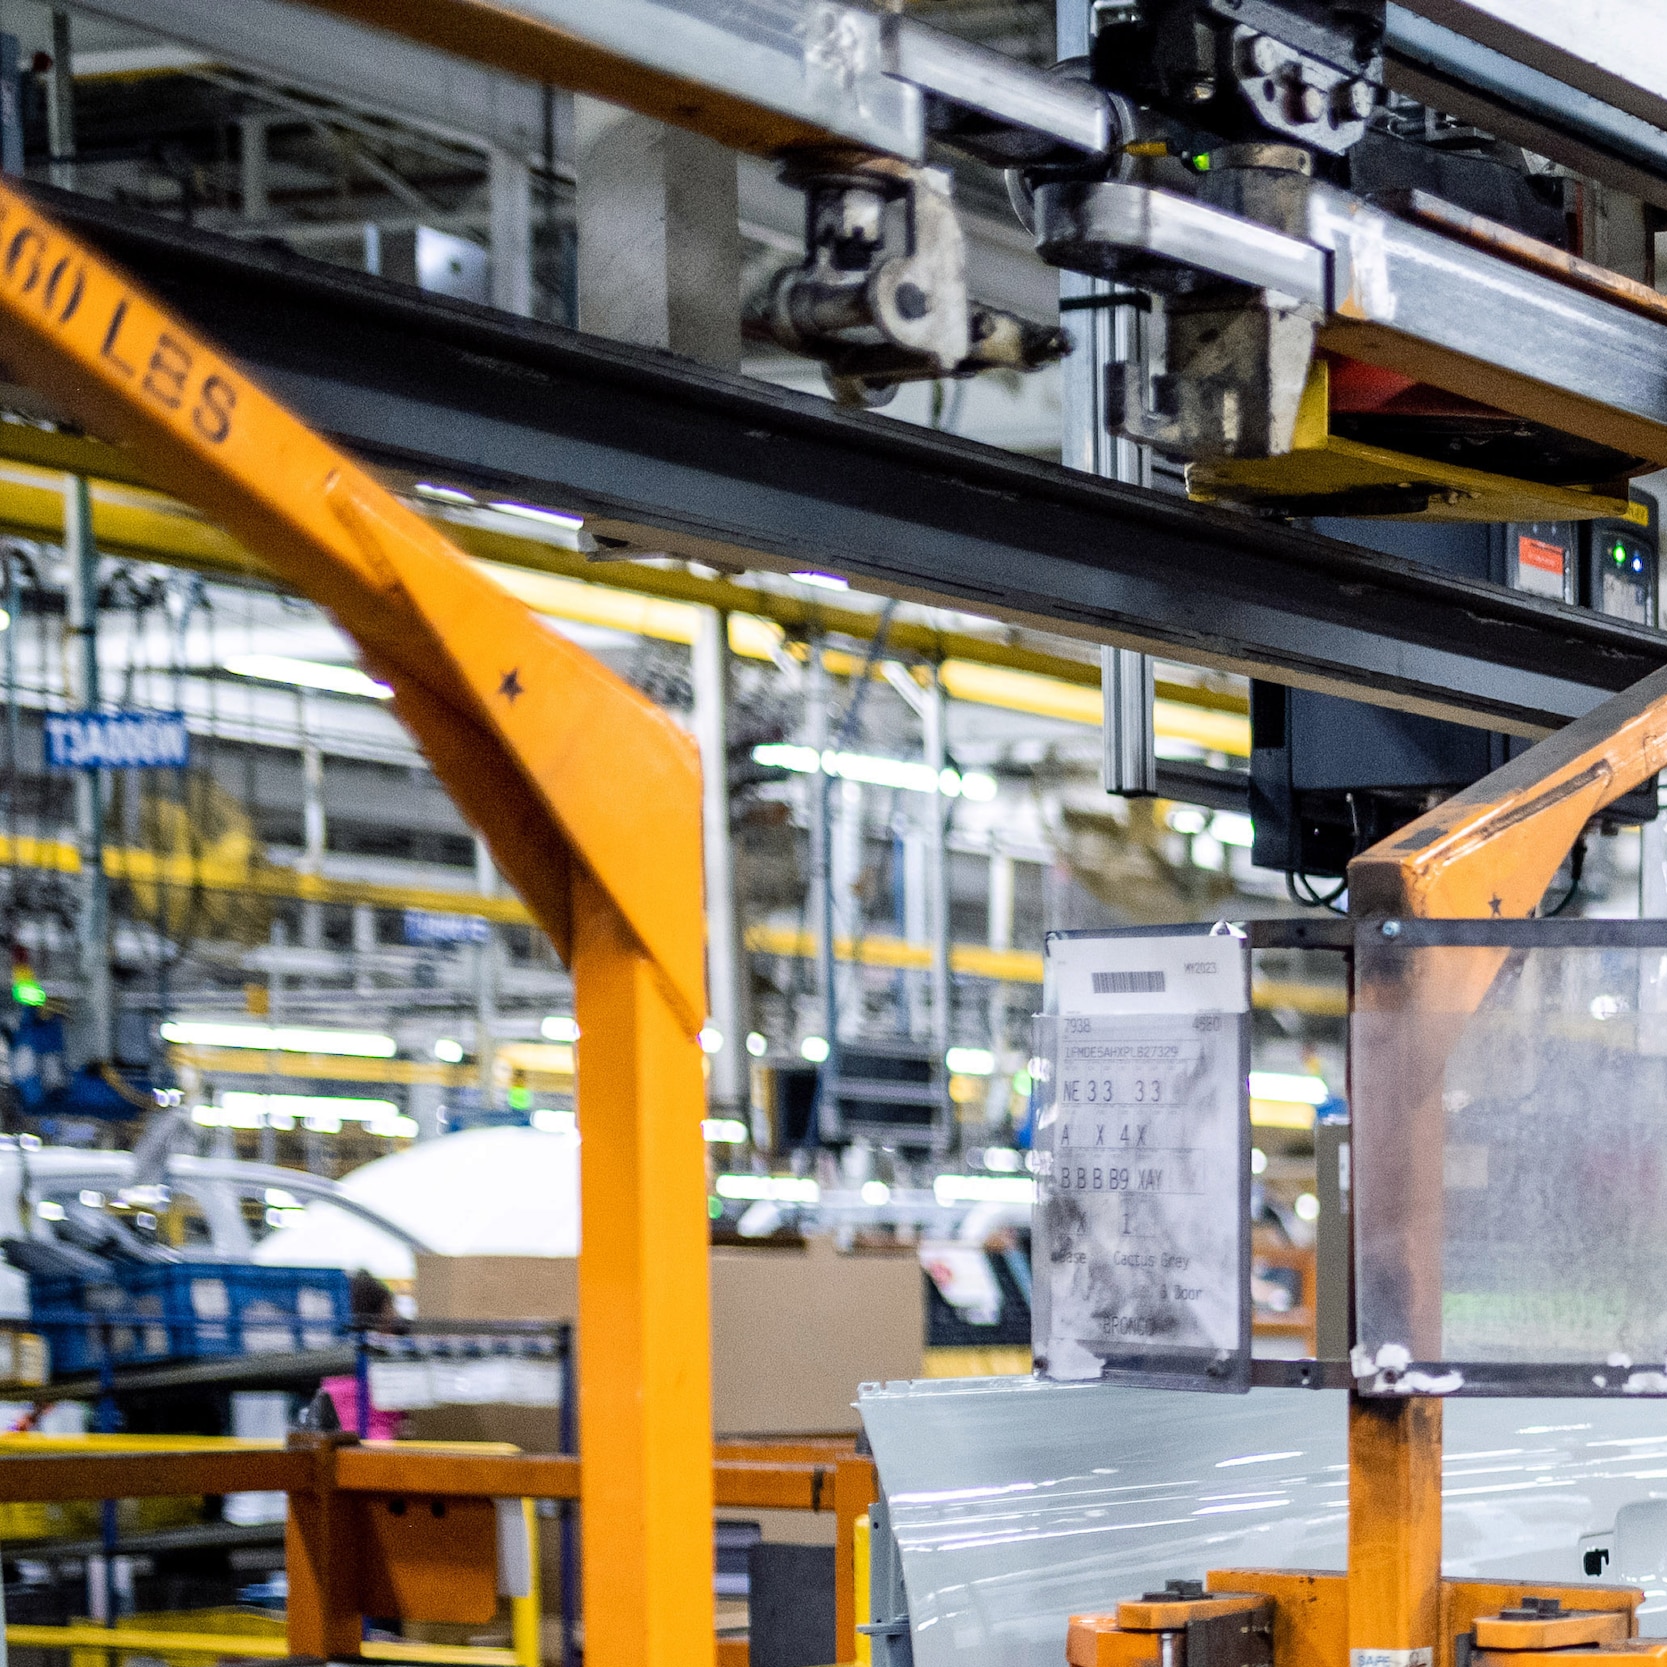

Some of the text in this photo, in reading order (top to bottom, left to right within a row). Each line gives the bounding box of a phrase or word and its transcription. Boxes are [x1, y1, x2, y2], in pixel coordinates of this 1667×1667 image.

[0, 205, 238, 443] 60 LBS
[1064, 1017, 1092, 1033] 7938
[1087, 1080, 1097, 1102] 3
[1103, 1080, 1112, 1102] 3
[1135, 1080, 1144, 1102] 3
[1151, 1080, 1161, 1102] 3
[1061, 1124, 1147, 1146] A X 4 X
[1061, 1167, 1070, 1189] B
[1077, 1167, 1086, 1189] B
[1093, 1168, 1102, 1190] B
[1113, 1251, 1155, 1267] Cactus
[1161, 1252, 1190, 1271] Grey
